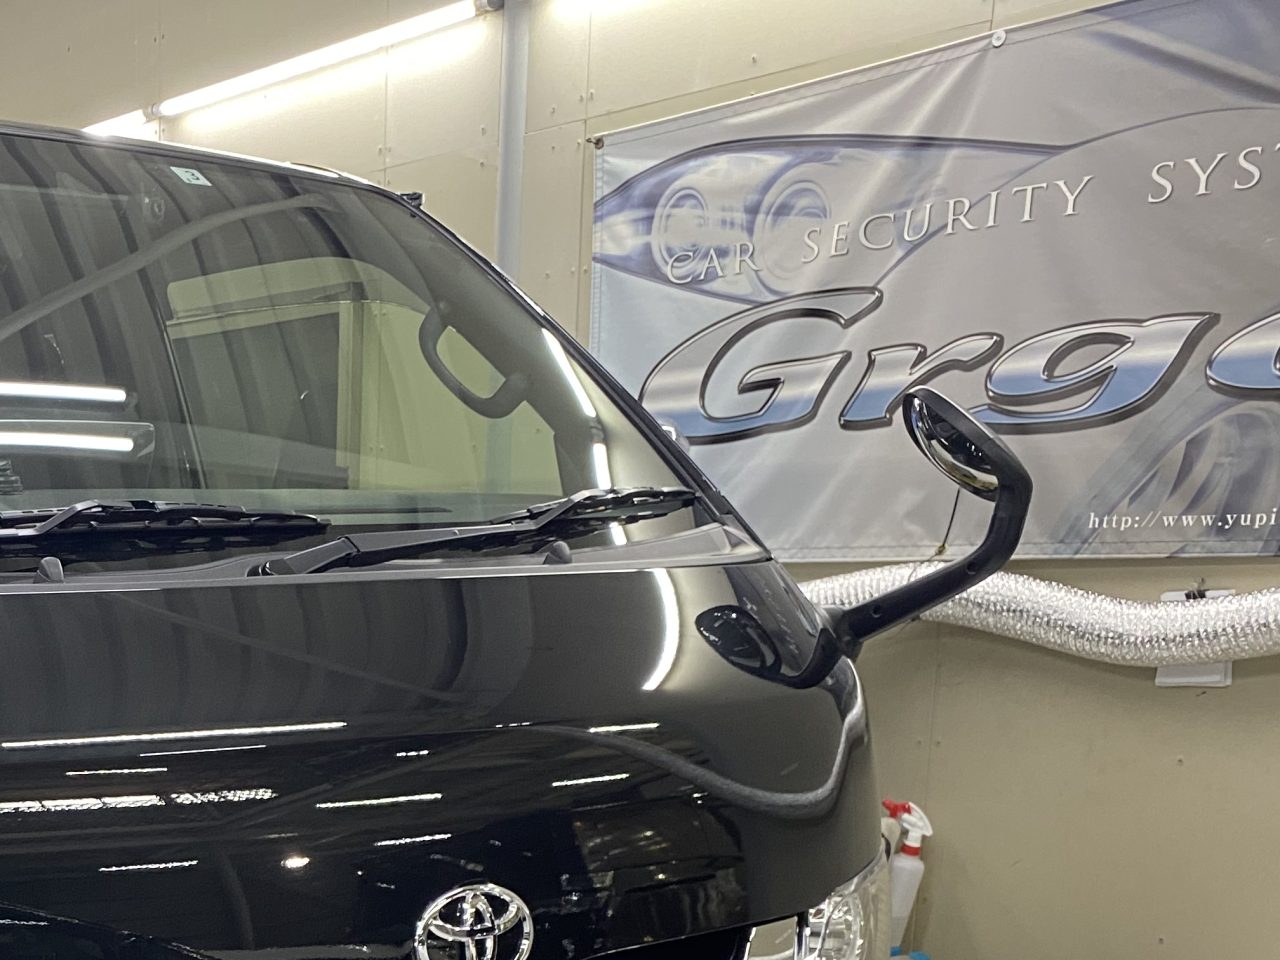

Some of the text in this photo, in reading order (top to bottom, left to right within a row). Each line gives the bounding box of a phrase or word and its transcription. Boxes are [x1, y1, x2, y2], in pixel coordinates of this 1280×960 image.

[667, 143, 1280, 285] CAR SECURITY SYS
[1088, 507, 1278, 531] http://www.yupi
